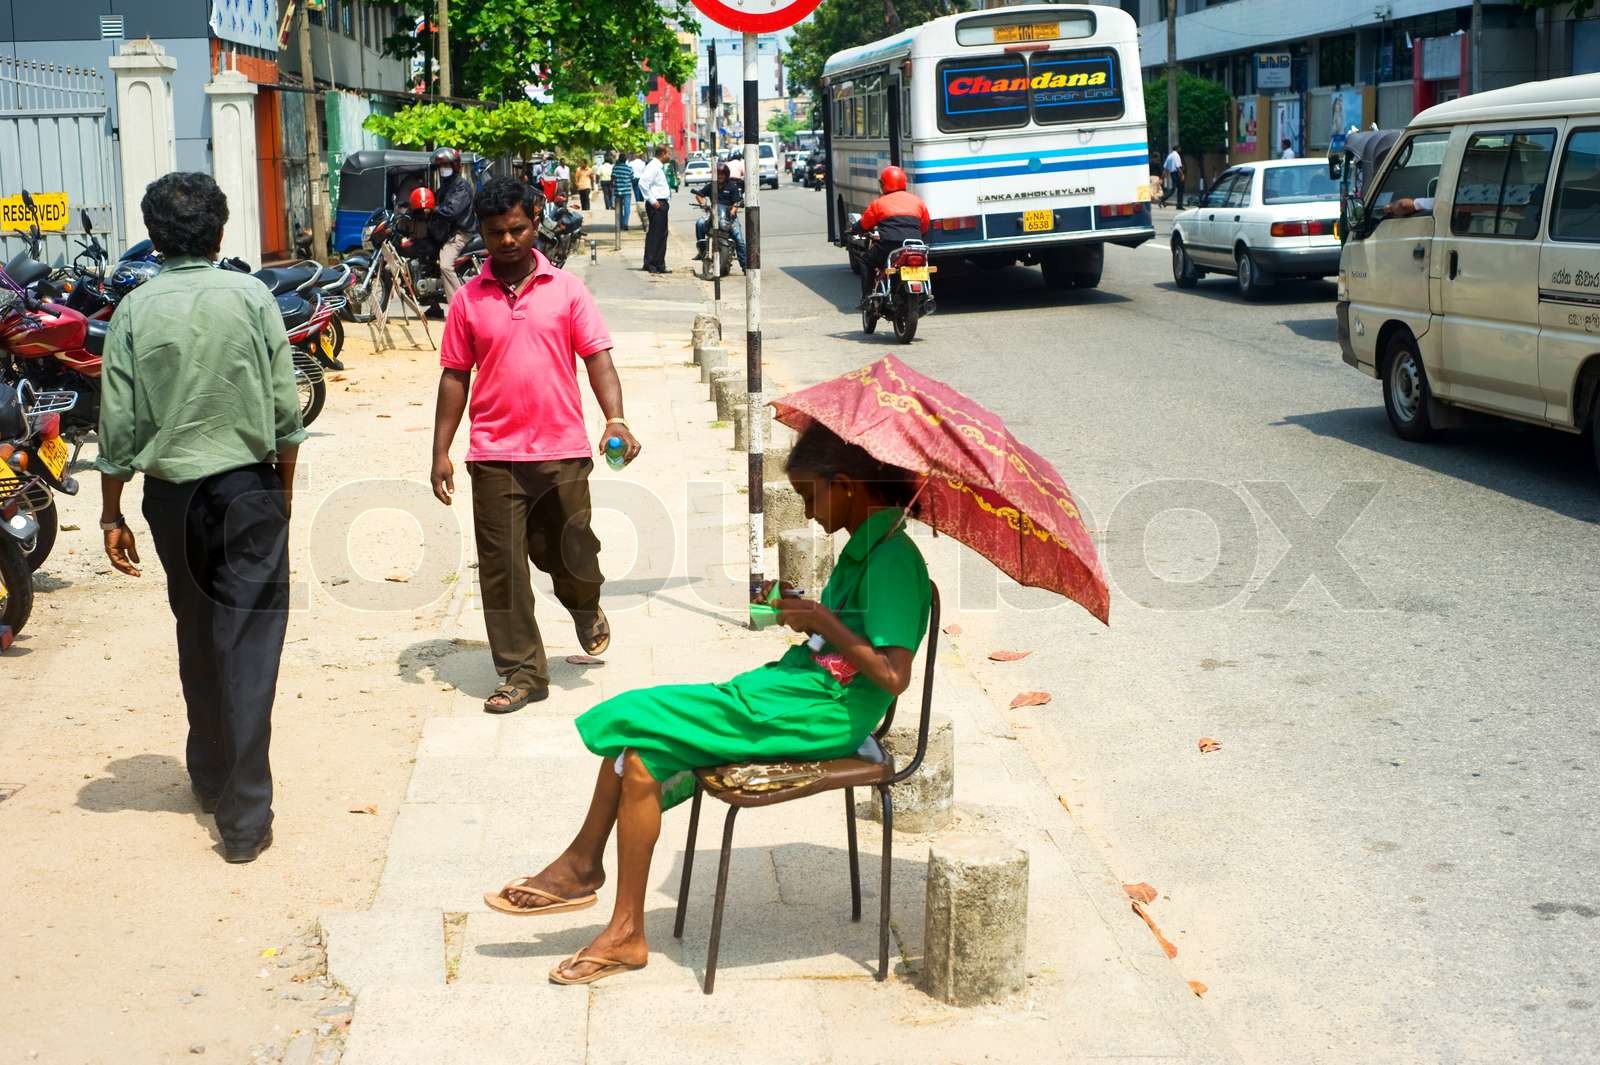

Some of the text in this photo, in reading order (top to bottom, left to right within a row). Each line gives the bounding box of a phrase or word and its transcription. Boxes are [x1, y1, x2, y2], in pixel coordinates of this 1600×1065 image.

[948, 71, 1107, 96] Chandana
[978, 186, 1095, 202] LANKA ASHOK LEYLAND
[1028, 220, 1049, 230] 6538
